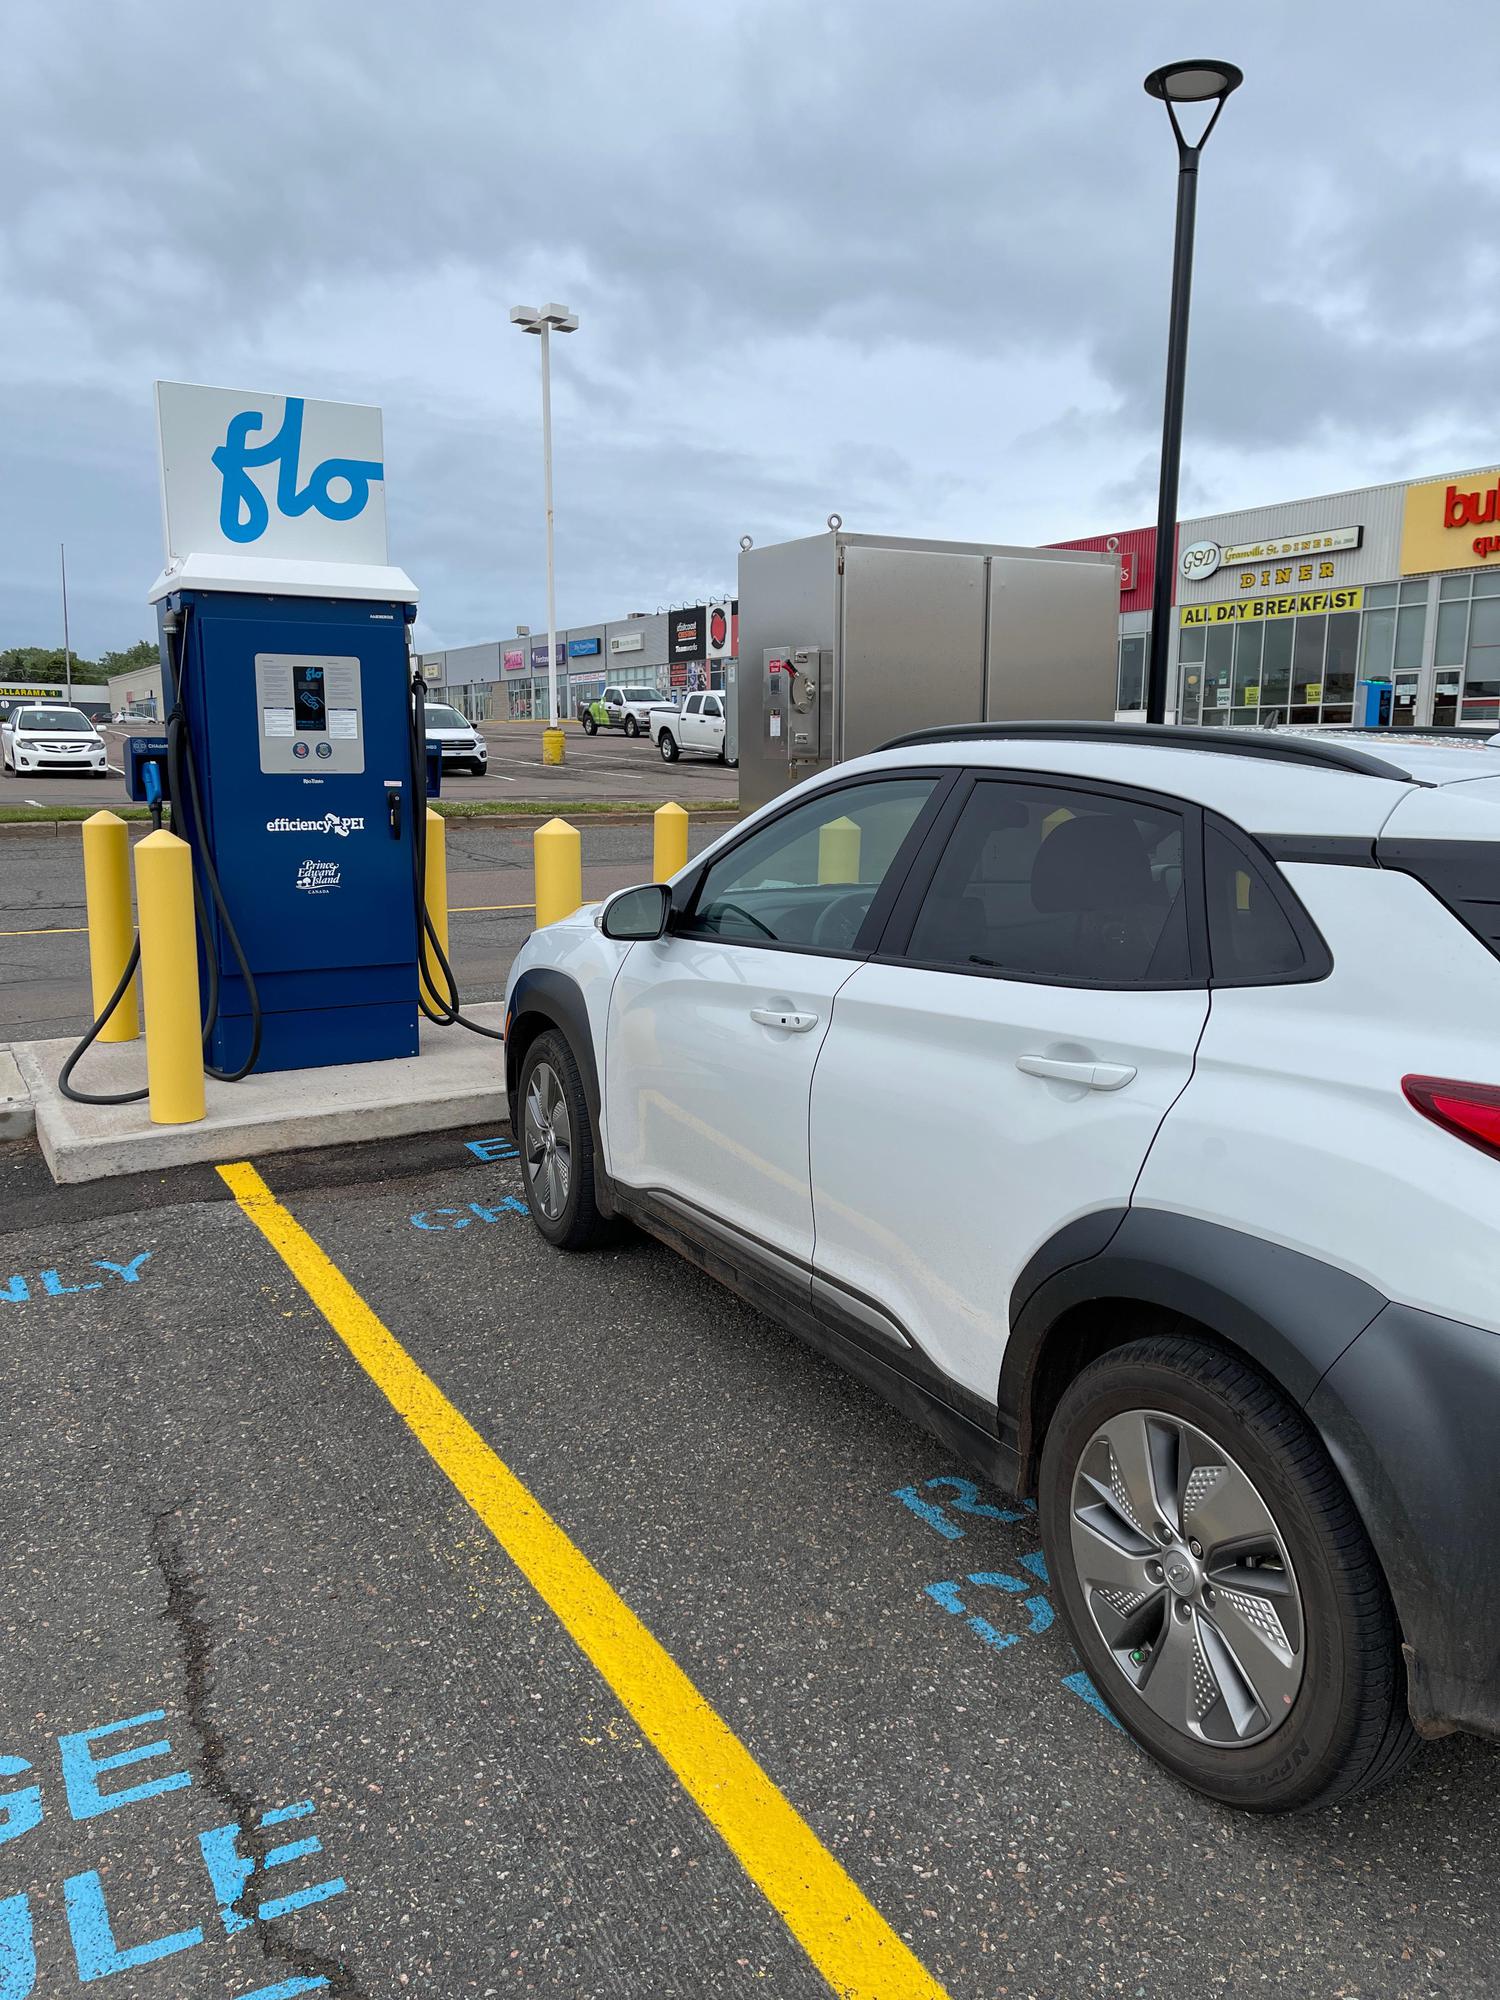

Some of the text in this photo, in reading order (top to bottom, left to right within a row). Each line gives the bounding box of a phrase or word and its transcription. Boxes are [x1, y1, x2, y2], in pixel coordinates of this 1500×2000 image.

[212, 397, 384, 543] flo
[1225, 544, 1265, 563] Granville
[1282, 537, 1333, 553] DINER
[1183, 548, 1217, 575] GSD
[1240, 562, 1334, 588] DINER
[1184, 592, 1358, 624] ALL DAY BREAKFAST
[305, 667, 324, 681] flo
[266, 817, 365, 834] efficiency PEI
[297, 866, 336, 878] Edward
[302, 860, 339, 870] Prince
[311, 873, 341, 886] Island
